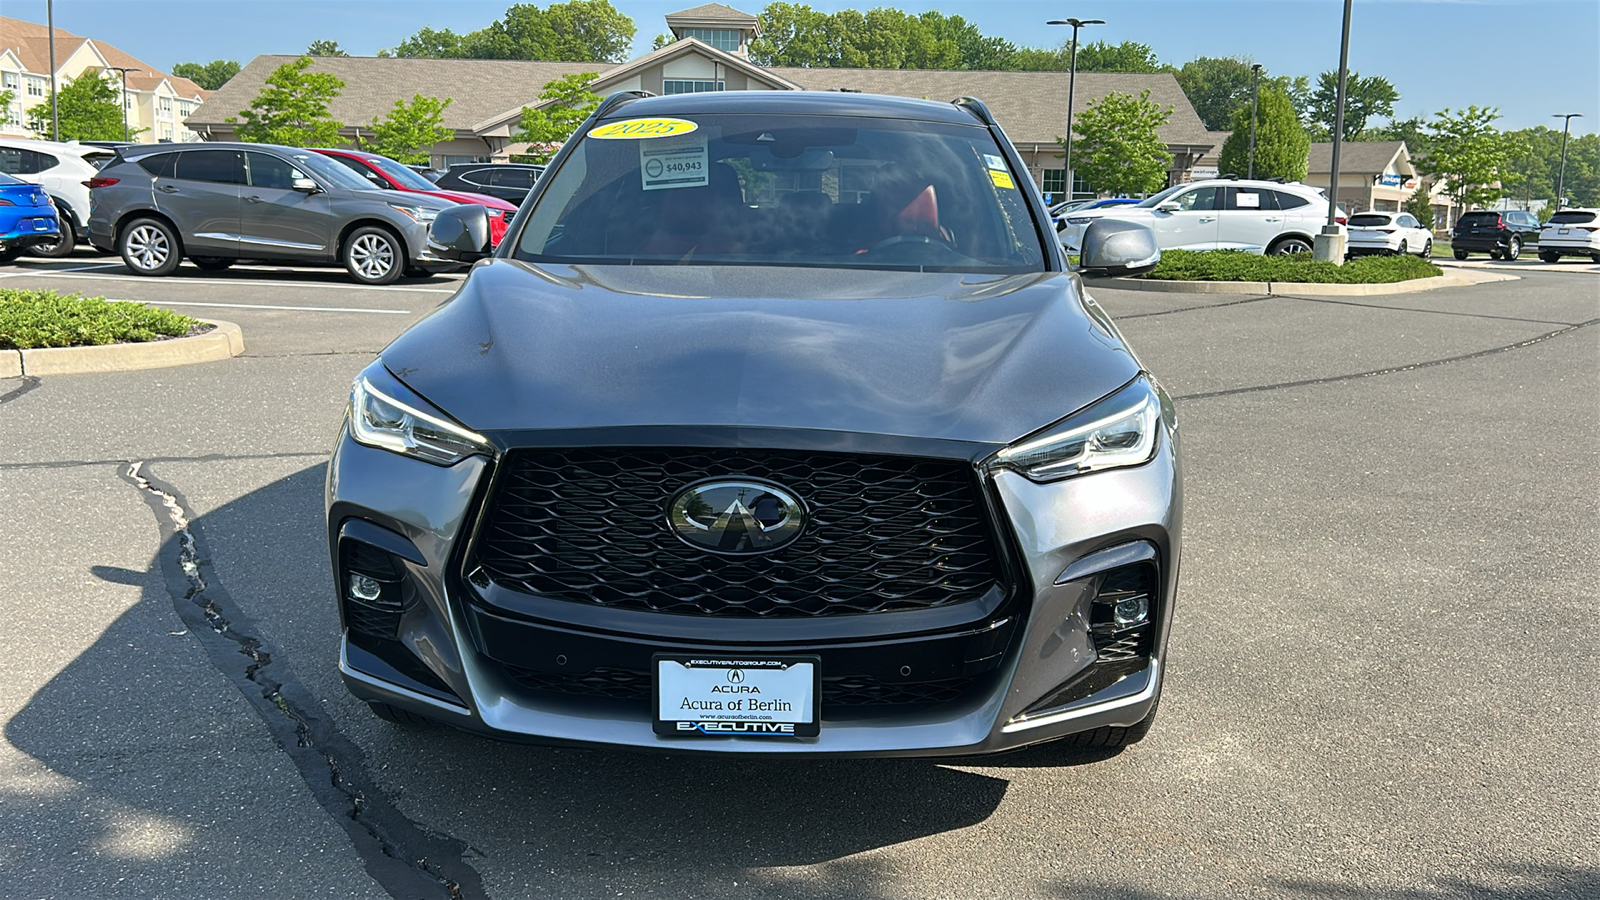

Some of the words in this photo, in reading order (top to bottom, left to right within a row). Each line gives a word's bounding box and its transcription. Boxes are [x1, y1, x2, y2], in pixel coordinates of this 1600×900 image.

[603, 122, 682, 135] 2025
[666, 161, 702, 173] $40,943
[711, 685, 761, 694] ACURA
[680, 697, 723, 710] Acura
[727, 699, 743, 711] of
[748, 698, 792, 711] Berlin
[676, 721, 795, 732] EXECUTIVE
